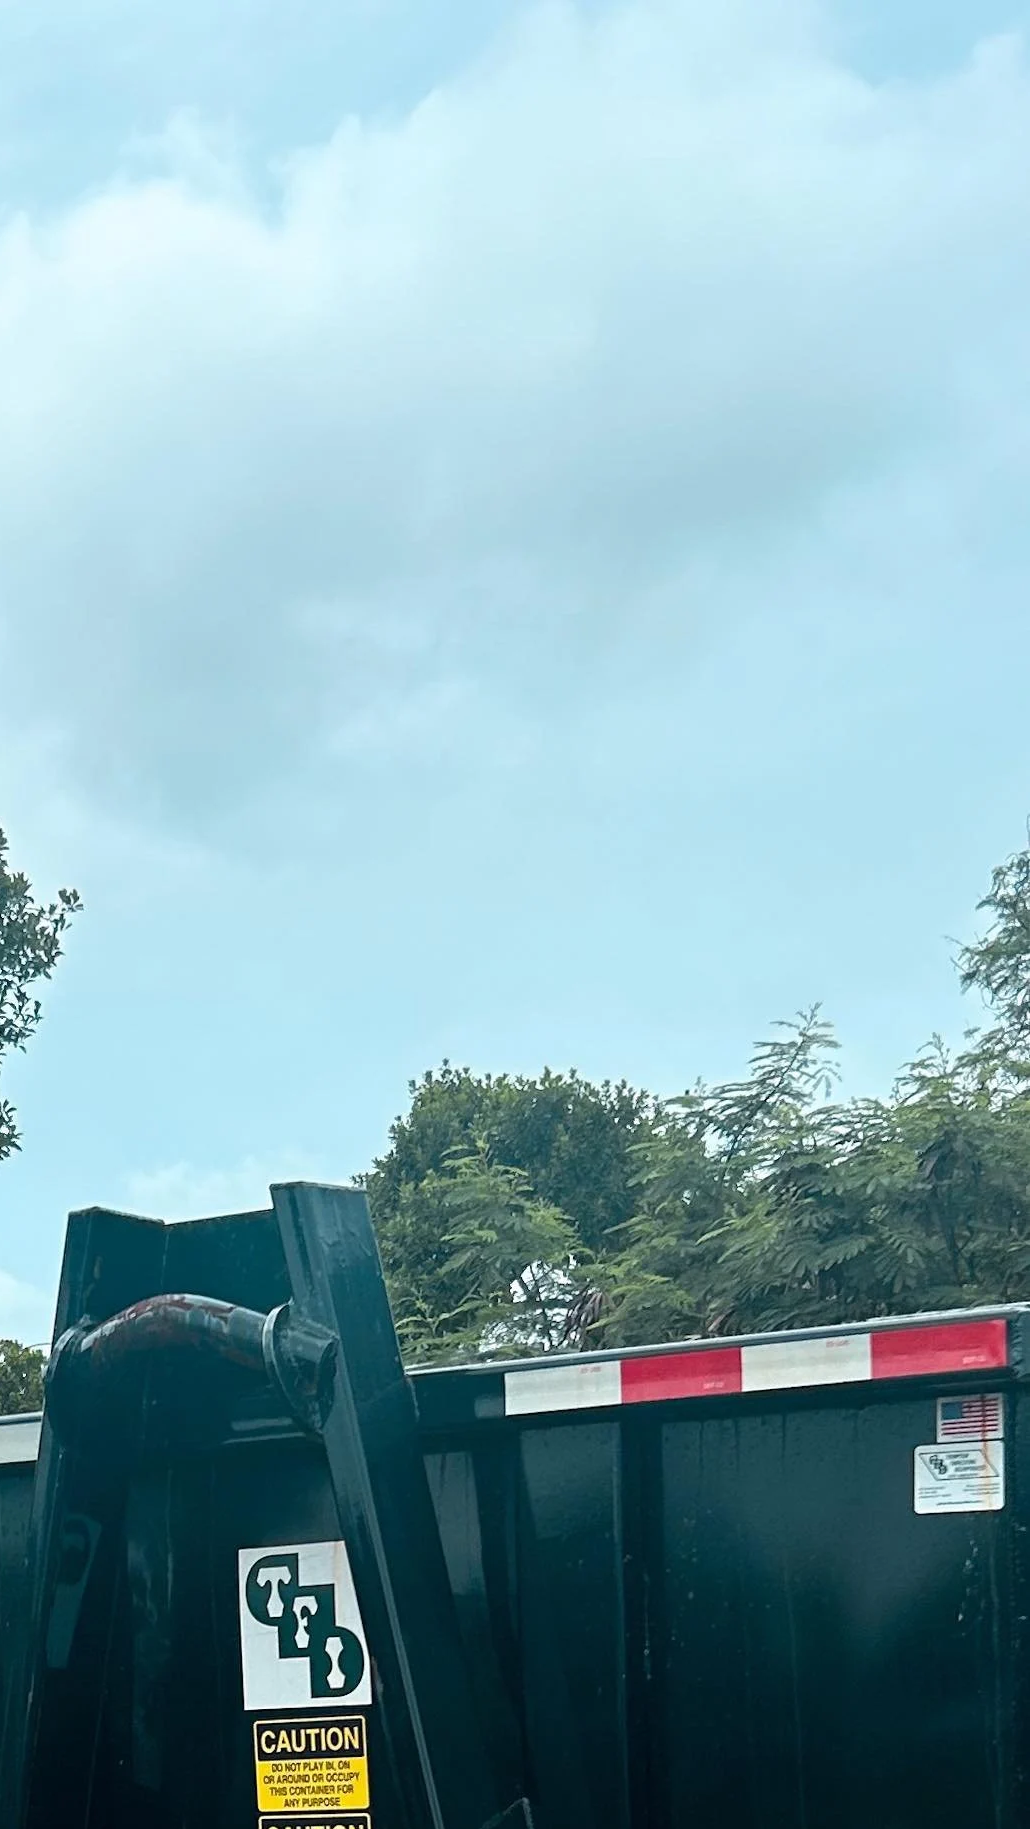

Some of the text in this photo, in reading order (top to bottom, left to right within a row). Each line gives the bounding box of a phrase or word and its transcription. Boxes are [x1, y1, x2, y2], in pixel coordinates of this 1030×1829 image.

[260, 1726, 360, 1754] CAUTION
[271, 1763, 283, 1773] DO
[285, 1762, 301, 1772] NOT
[303, 1761, 324, 1771] PLAY
[337, 1760, 350, 1770] ON
[263, 1772, 360, 1784] OR AROUND OR OCCUPY
[269, 1784, 354, 1796] THIS CONTAINER FOR
[284, 1797, 341, 1808] ANY PURPOSE
